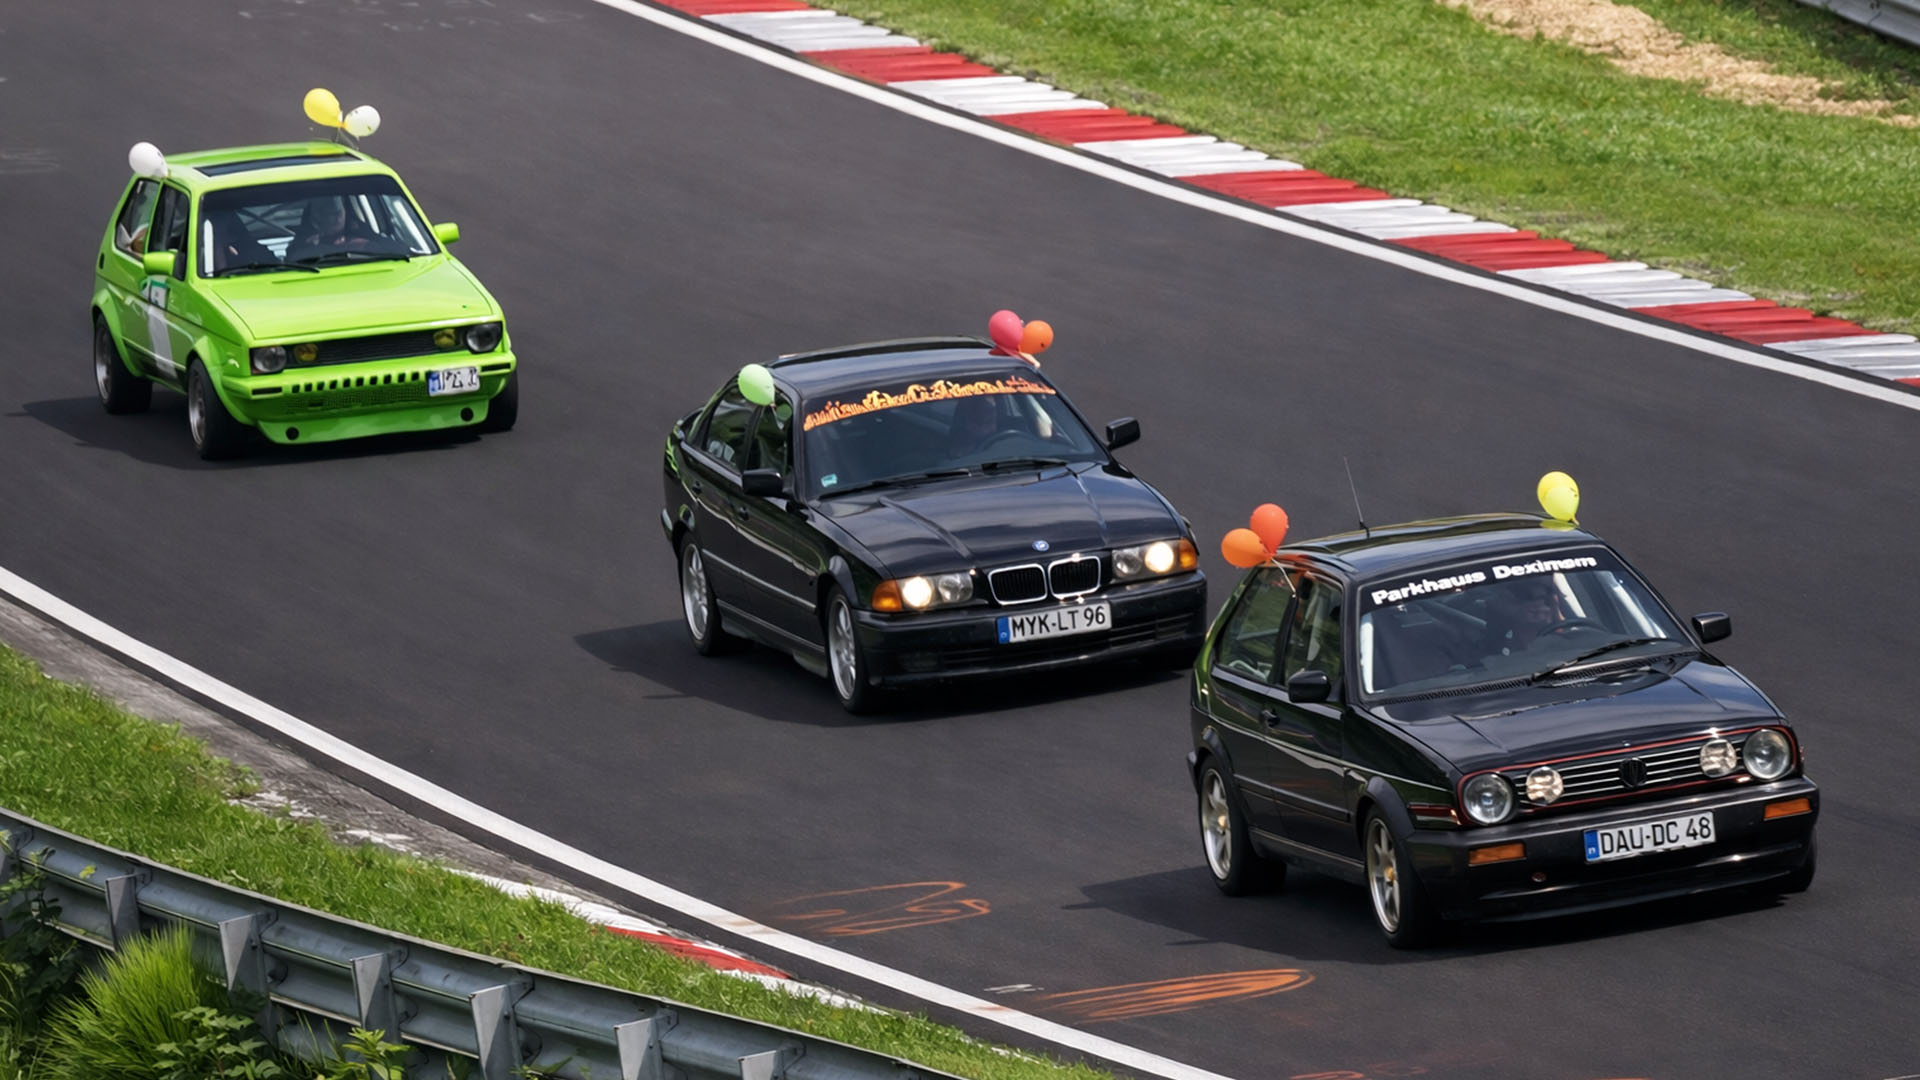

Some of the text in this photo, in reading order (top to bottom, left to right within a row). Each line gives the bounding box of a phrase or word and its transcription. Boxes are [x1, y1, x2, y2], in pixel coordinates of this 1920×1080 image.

[1371, 571, 1487, 605] Parkhaus
[1011, 605, 1106, 638] MYK-LT 96
[1600, 816, 1712, 855] DAU-DC 48
